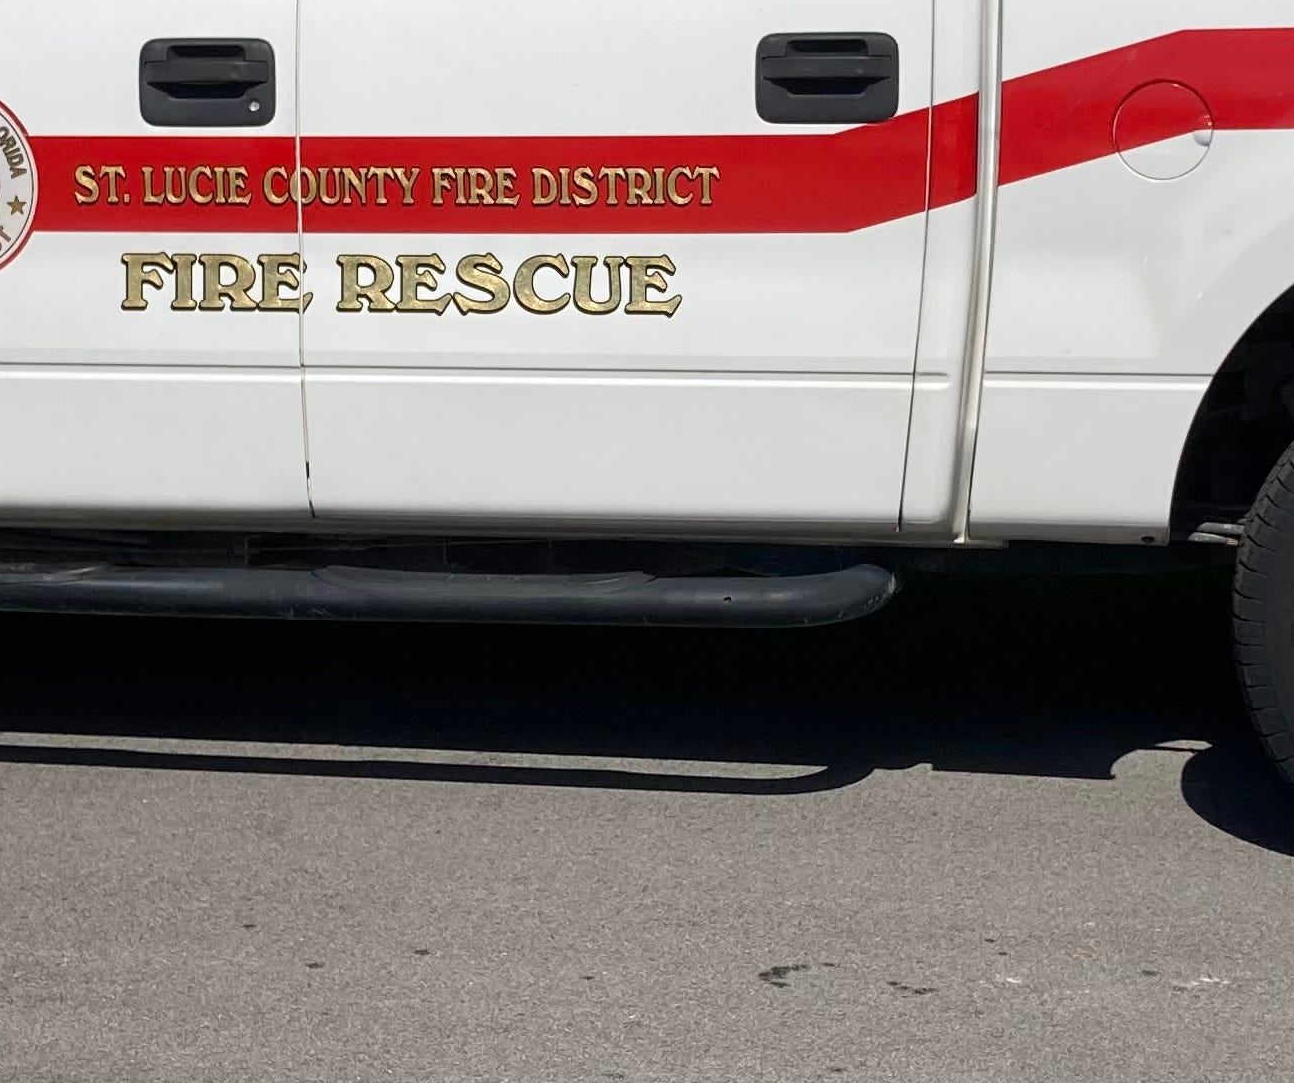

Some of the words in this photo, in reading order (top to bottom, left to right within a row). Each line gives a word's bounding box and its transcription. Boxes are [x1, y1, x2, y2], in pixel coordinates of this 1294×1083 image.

[73, 164, 130, 206] ST.
[142, 165, 253, 206] LUCIE
[262, 166, 421, 207] COUNTY
[431, 167, 521, 207] FIRE
[530, 165, 720, 207] DISTRICT
[120, 251, 313, 313] FIRE
[335, 251, 684, 317] RESCUE
